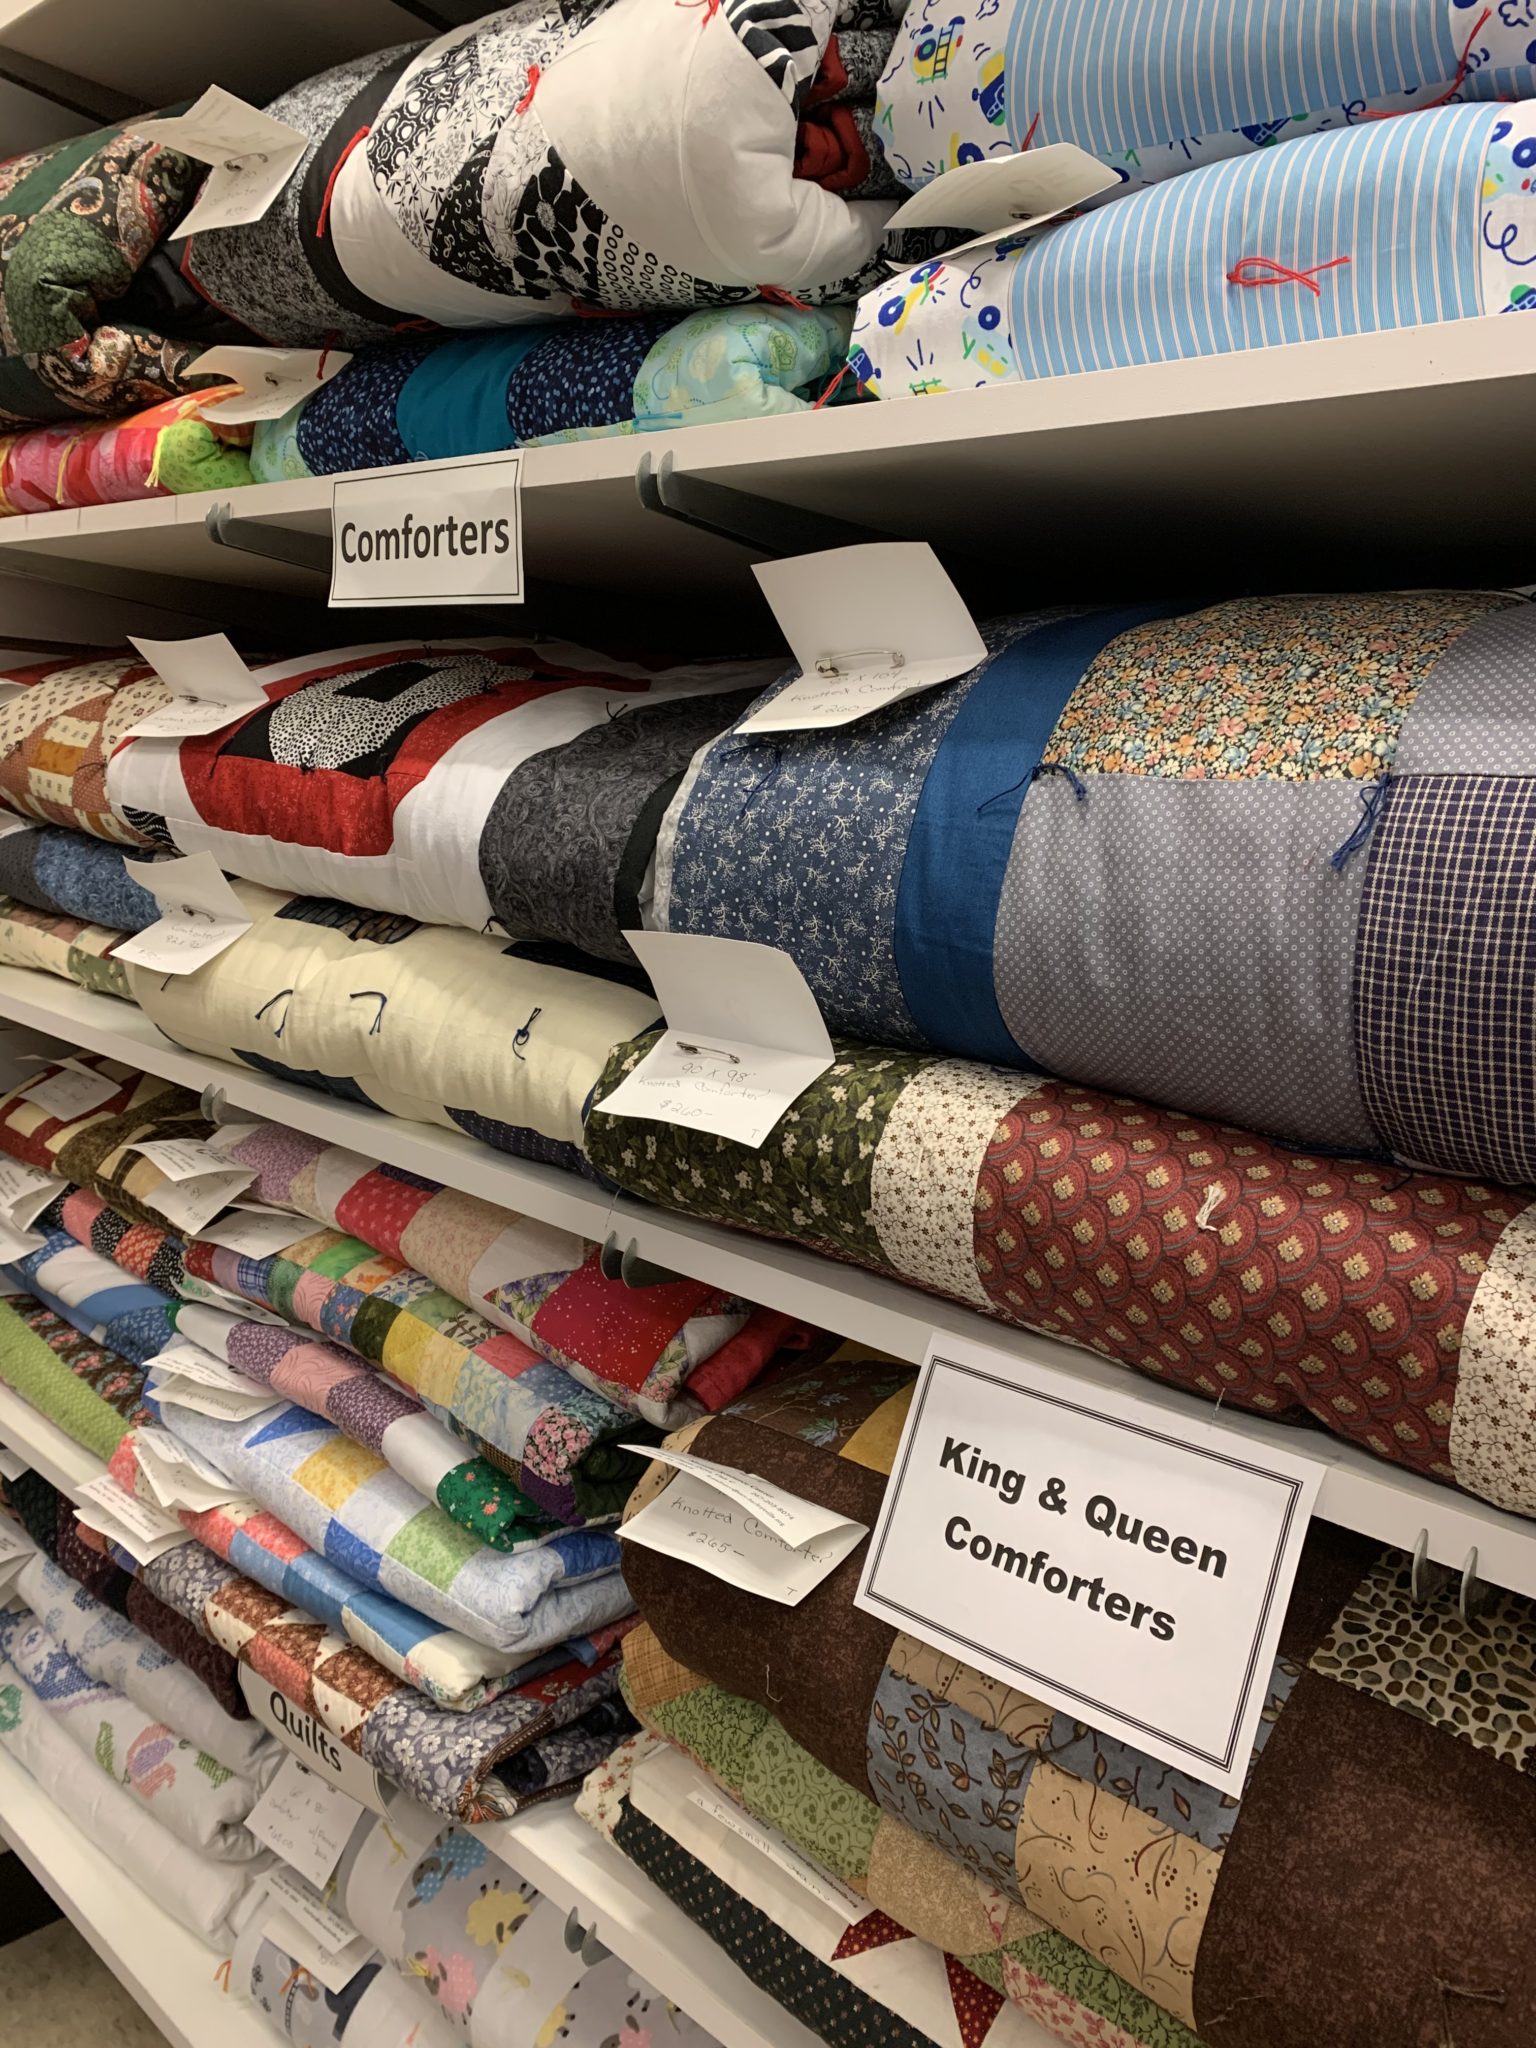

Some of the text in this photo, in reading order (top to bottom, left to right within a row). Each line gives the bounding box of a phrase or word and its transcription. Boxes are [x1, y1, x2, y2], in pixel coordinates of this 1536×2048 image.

[341, 513, 510, 564] Comforters
[682, 1062, 703, 1074] 90
[694, 1081, 771, 1101] Comforter
[671, 1496, 732, 1525] Knotted
[938, 1436, 1228, 1579] King & Queen
[944, 1516, 1176, 1642] Comforters
[270, 1691, 342, 1772] Quilts
